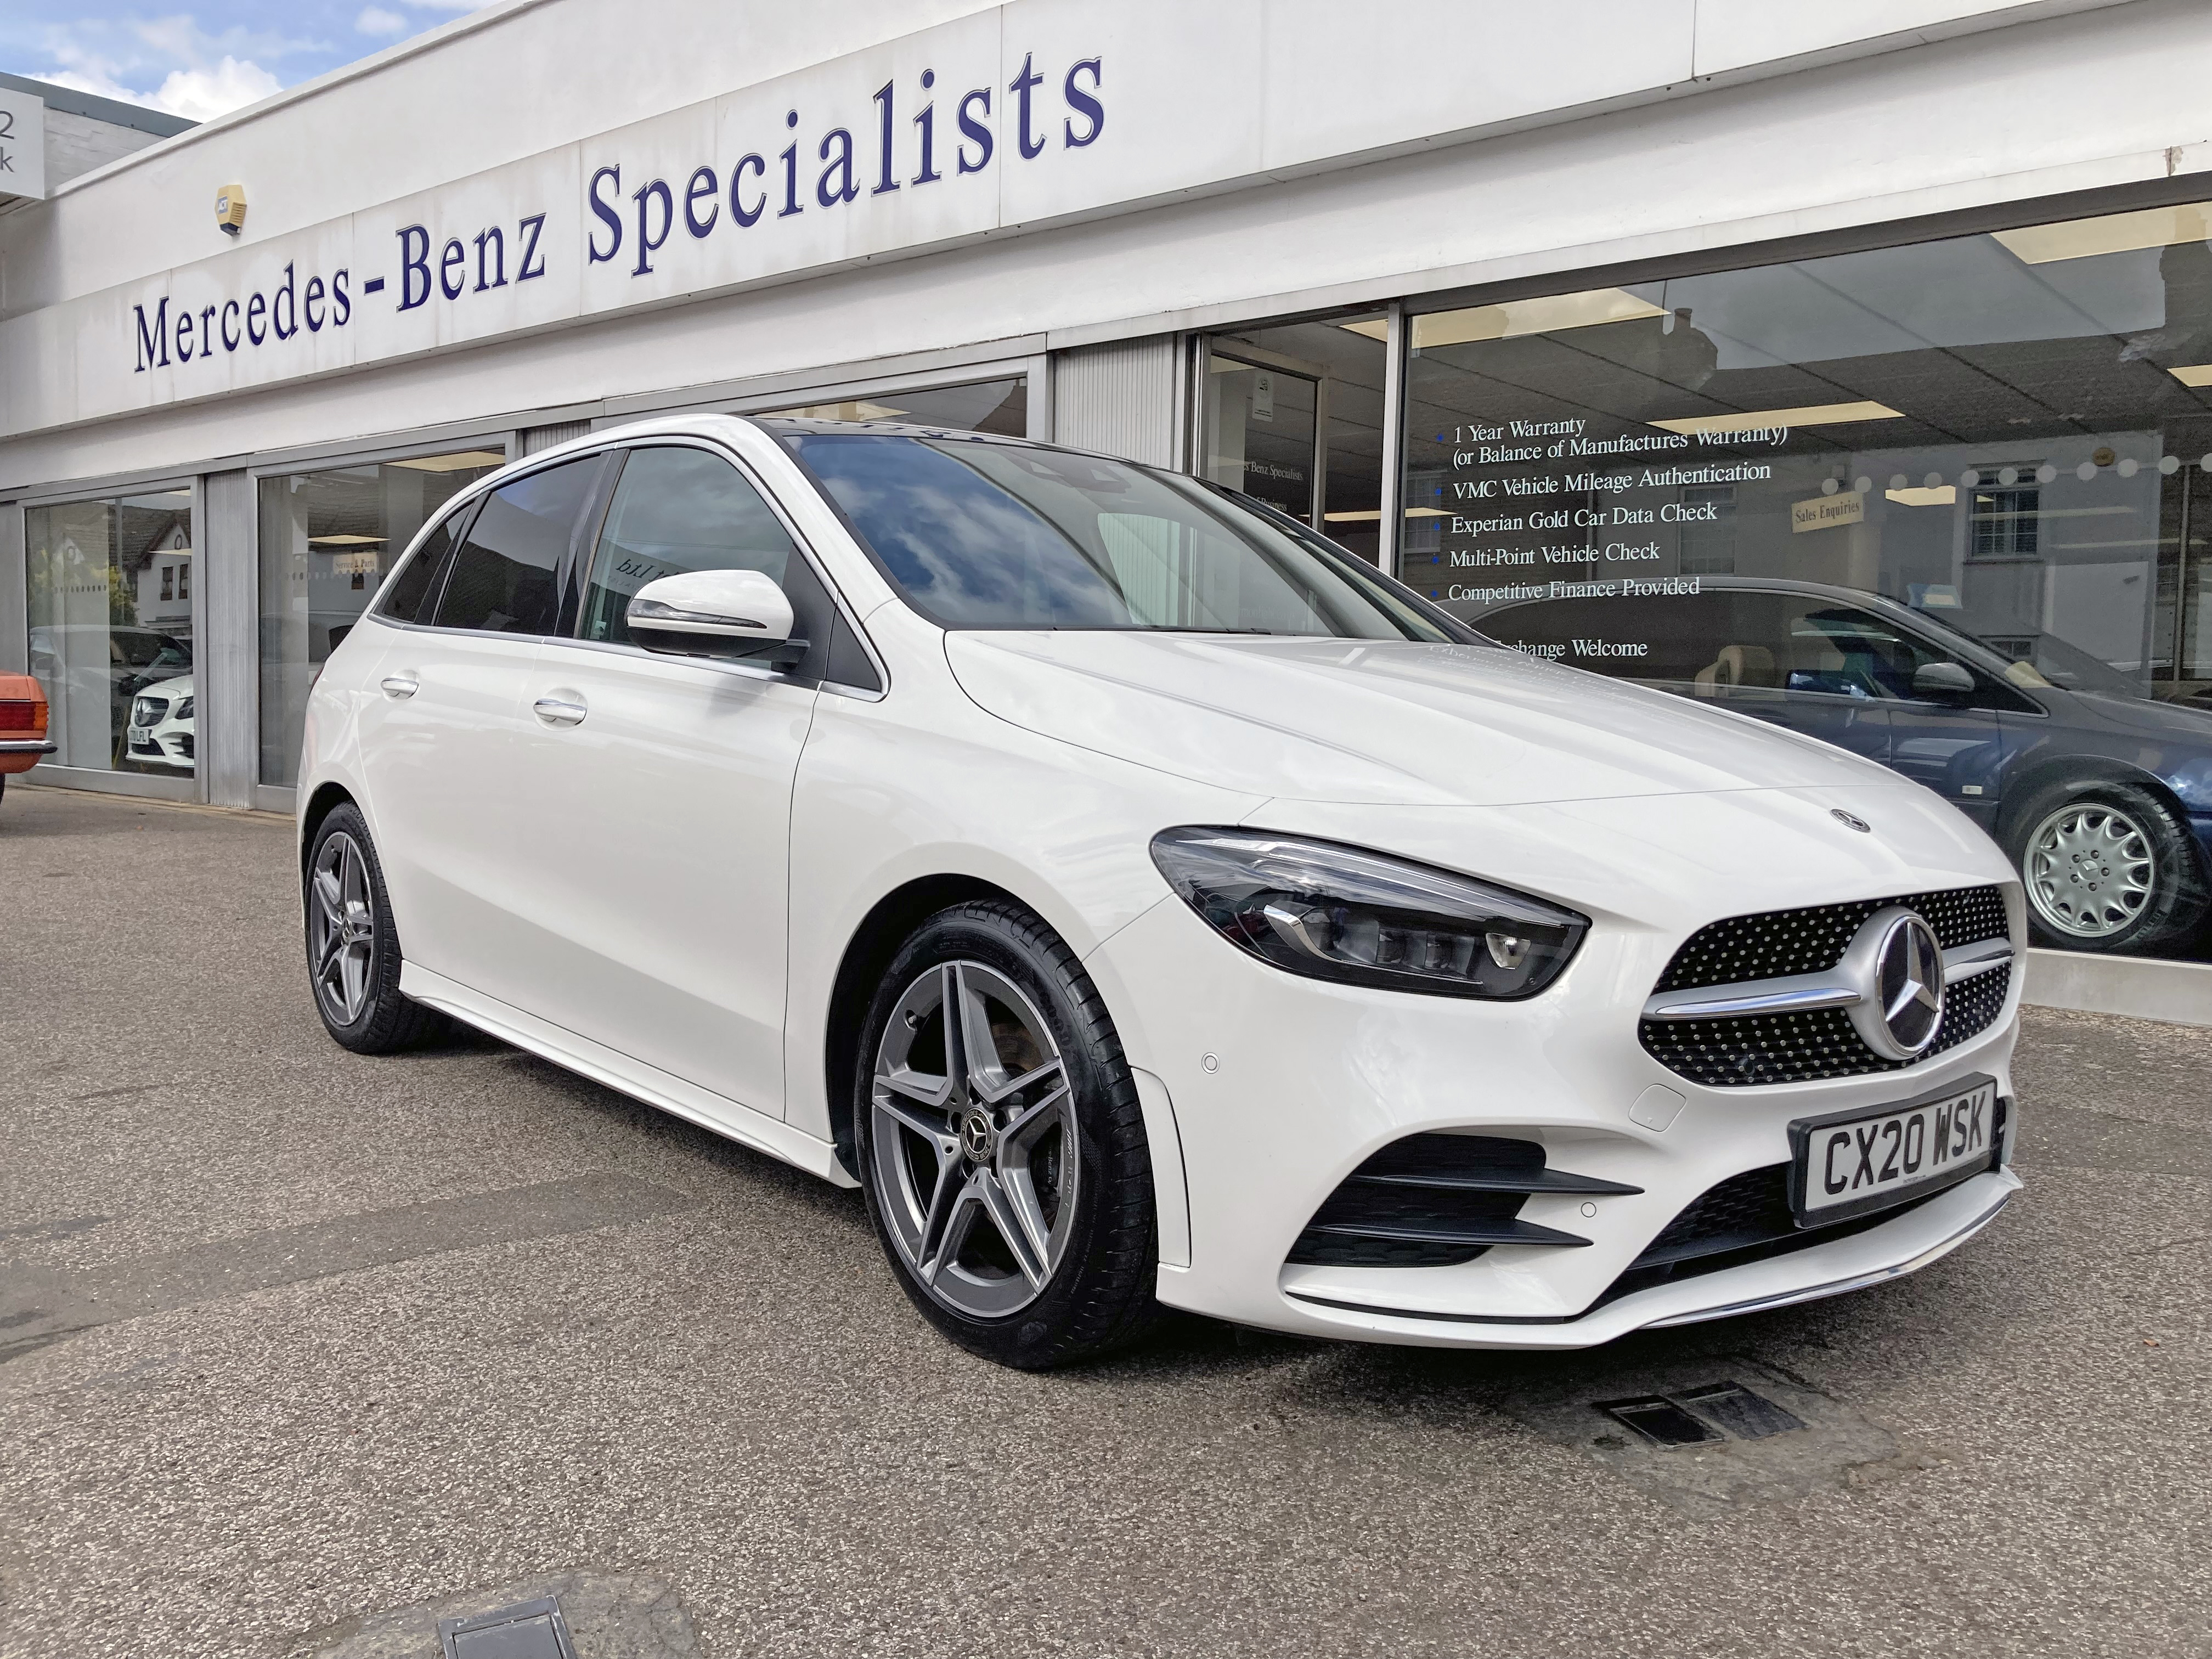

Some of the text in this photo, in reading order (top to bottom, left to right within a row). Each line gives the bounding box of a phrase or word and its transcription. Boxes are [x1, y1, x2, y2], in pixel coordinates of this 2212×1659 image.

[133, 52, 1104, 374] Mercedes-Benz Specialists
[1454, 417, 1586, 443] 1 Year Warranty
[1453, 422, 1788, 470] (or Balance of Manufactures Warranty)
[1251, 461, 1268, 475] Benz
[1269, 465, 1304, 481] Specialists
[1453, 461, 1771, 499] VMC Vehicle Mileage Authentication
[1451, 501, 1718, 537] Experian Gold Car Data Check
[1796, 500, 1860, 523] Sales Enquiries
[361, 558, 375, 568] Parts
[1449, 541, 1661, 567] Multi-Point Vehicle Check
[1448, 577, 1701, 605] Competitive Finance Provided
[1494, 639, 1649, 662] change Welcome
[1824, 1091, 1986, 1195] CX20 WSK
